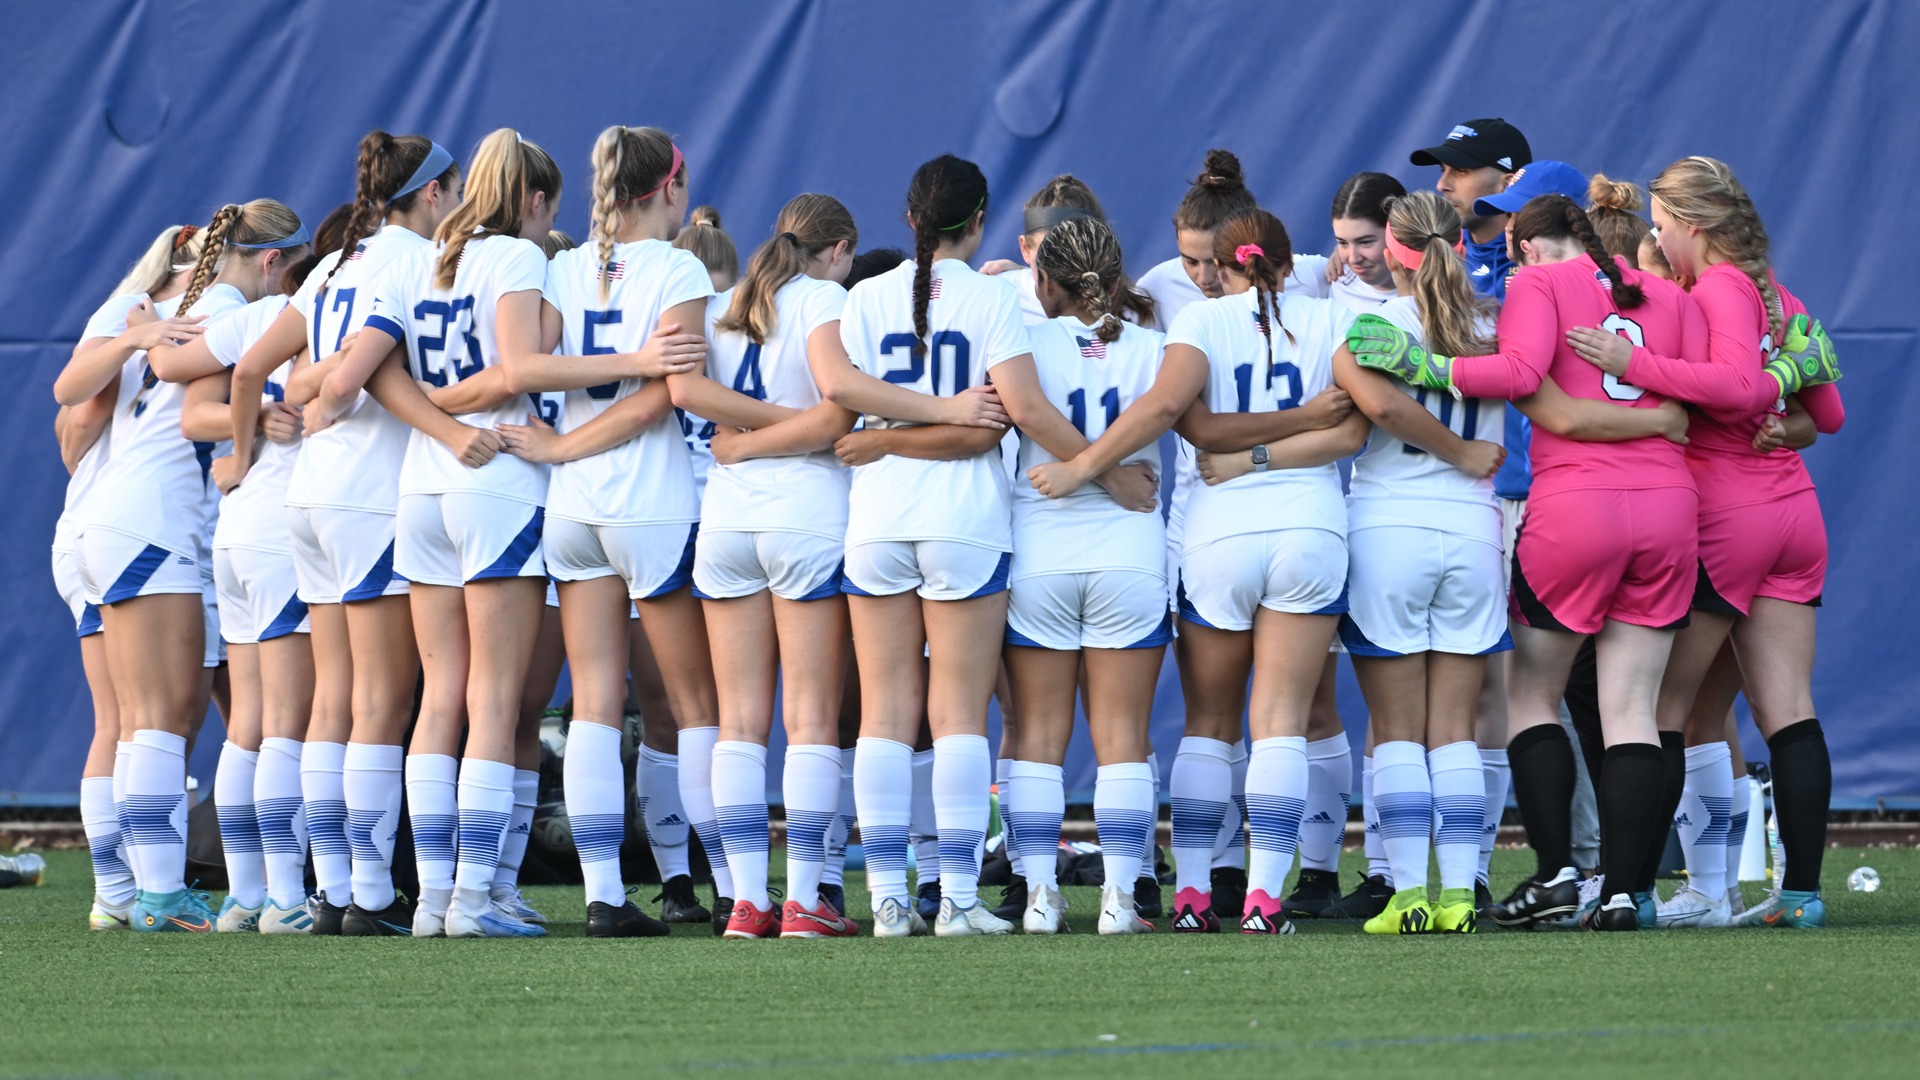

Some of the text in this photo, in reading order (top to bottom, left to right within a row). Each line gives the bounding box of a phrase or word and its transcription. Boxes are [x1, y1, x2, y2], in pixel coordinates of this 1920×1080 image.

[314, 287, 356, 363] 17
[414, 294, 484, 388] 23
[582, 309, 623, 400] 5
[733, 342, 767, 400] 4
[880, 330, 970, 397] 20
[1068, 386, 1120, 436] 11
